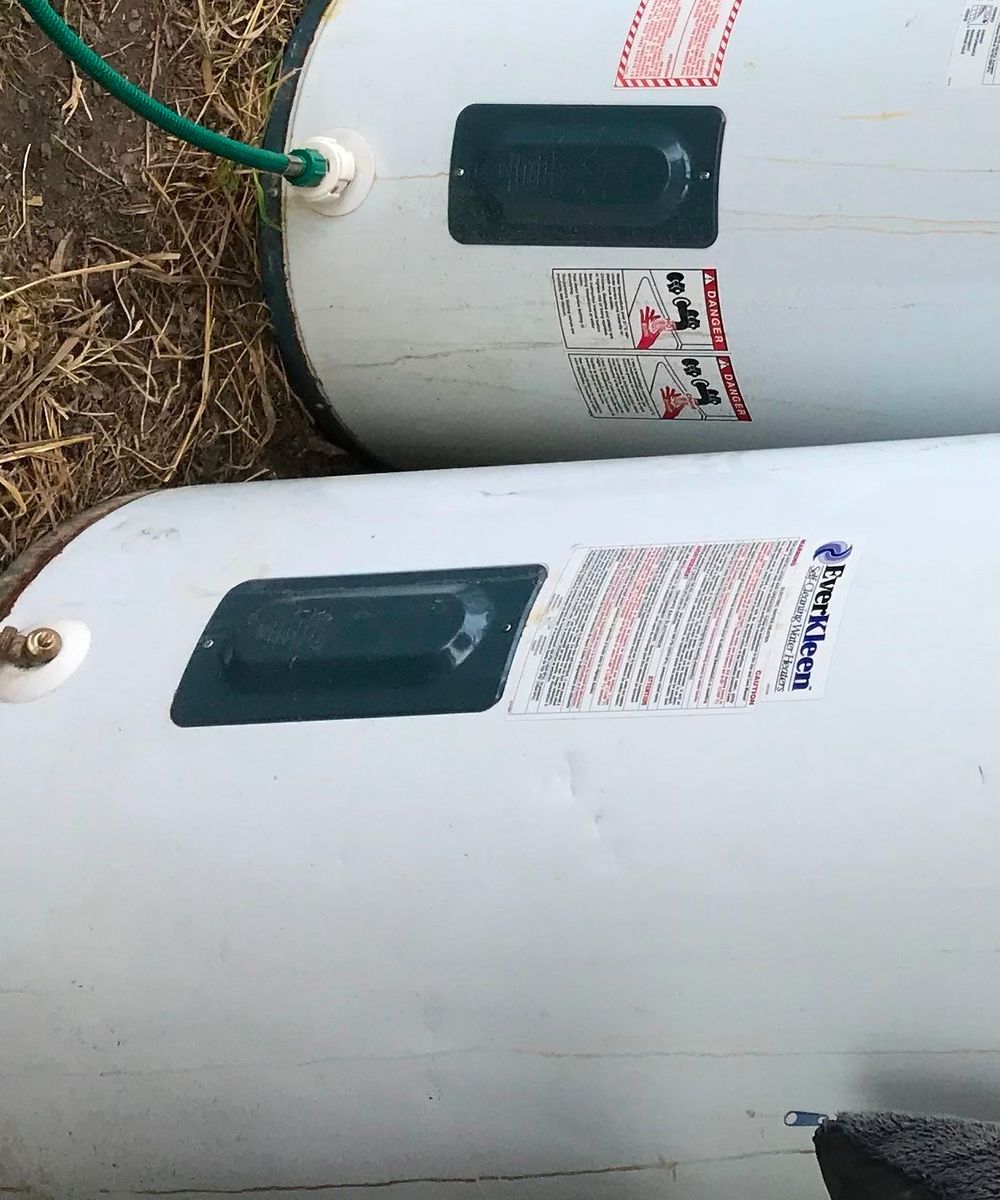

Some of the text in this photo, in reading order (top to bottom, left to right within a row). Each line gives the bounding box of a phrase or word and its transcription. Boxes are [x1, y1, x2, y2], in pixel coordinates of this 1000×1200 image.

[708, 290, 723, 343] DANGER
[724, 374, 747, 416] DANGER
[777, 566, 820, 692] Self-Cleaning Water Heaters
[792, 564, 846, 691] EverKleen
[749, 670, 762, 705] CAUTION
